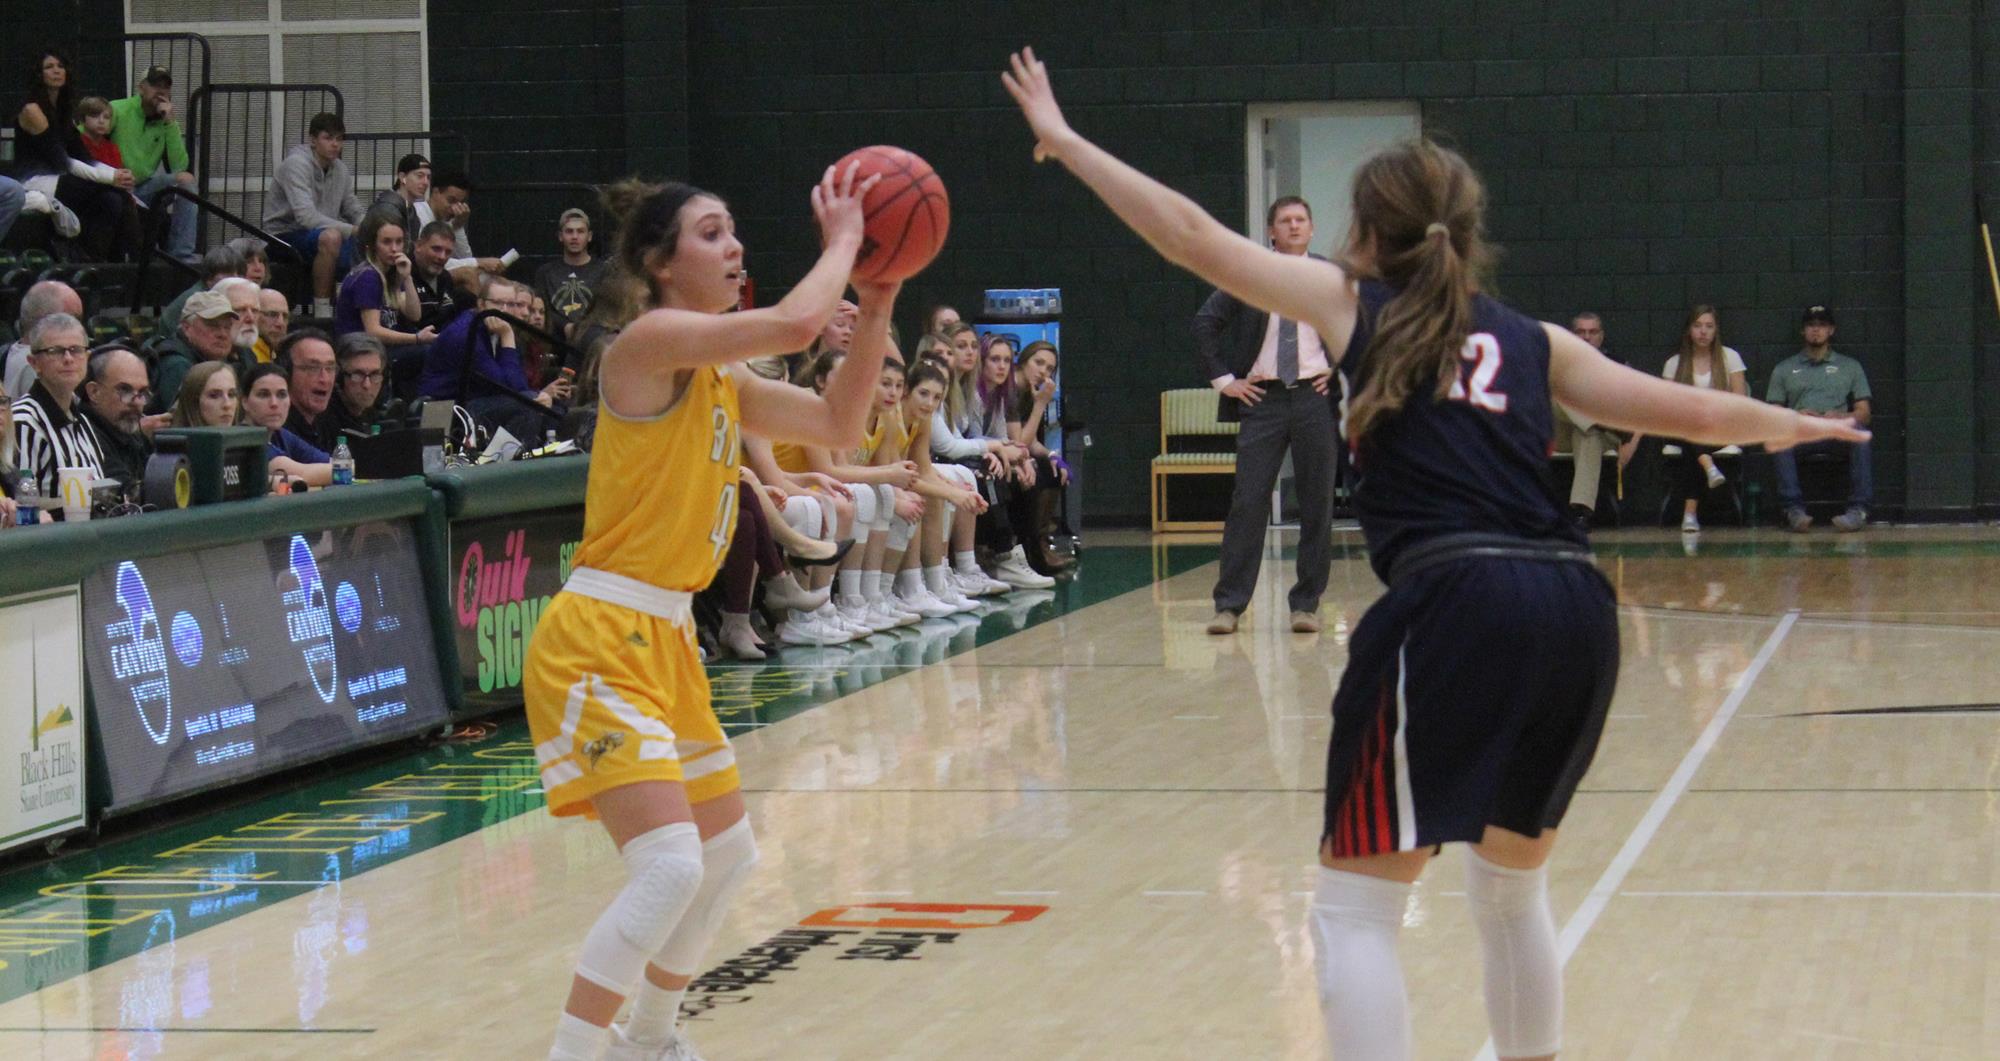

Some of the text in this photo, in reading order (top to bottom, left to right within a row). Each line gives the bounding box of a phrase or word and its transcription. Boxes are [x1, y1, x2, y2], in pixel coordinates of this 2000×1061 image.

[709, 483, 736, 560] 4
[457, 529, 531, 628] Quik
[20, 741, 77, 786] Black Hills
[152, 811, 449, 859] THE
[37, 866, 280, 901] OF
[686, 929, 862, 993] Interstate
[835, 930, 961, 962] First
